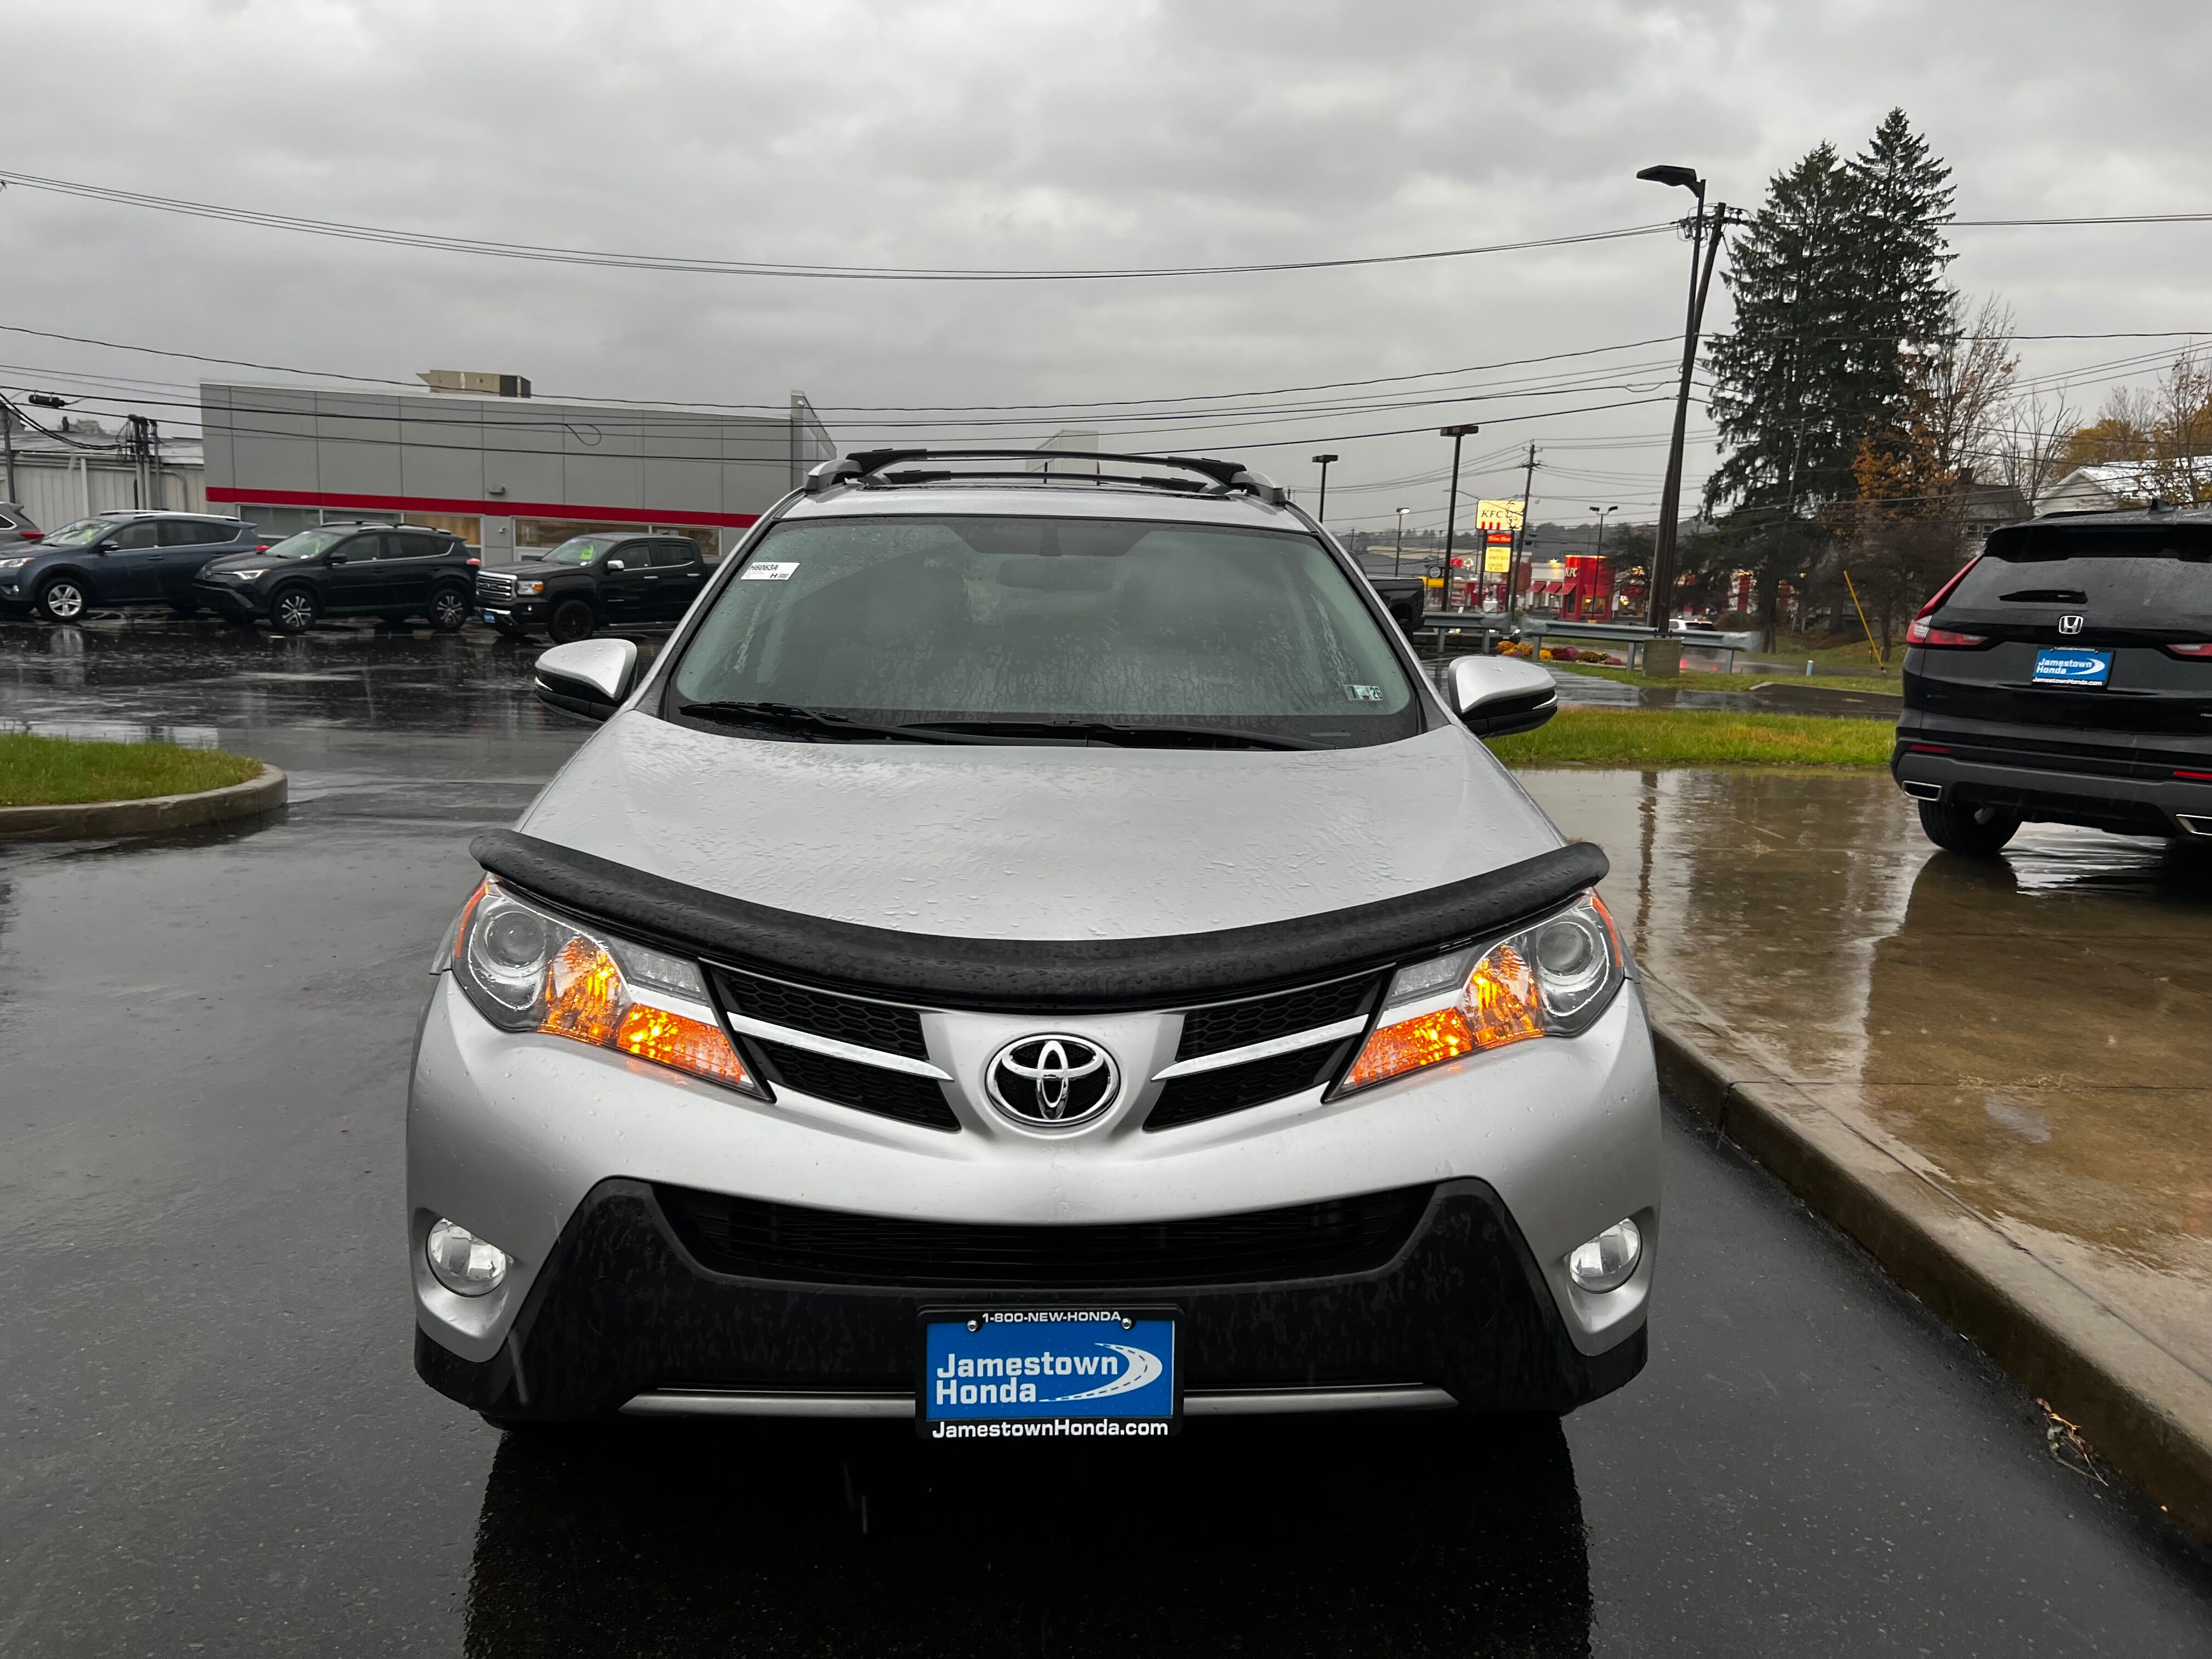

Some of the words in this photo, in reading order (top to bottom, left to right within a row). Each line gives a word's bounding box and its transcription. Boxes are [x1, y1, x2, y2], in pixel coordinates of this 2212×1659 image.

[1481, 510, 1503, 518] KFC
[2038, 658, 2092, 668] Jamestown
[2036, 665, 2067, 674] Honda
[982, 1311, 1121, 1323] 1-800-NEW-HONDA
[936, 1352, 1119, 1378] Jamestown
[936, 1377, 1036, 1404] Honda
[932, 1419, 1169, 1438] JamestownHonda.com
